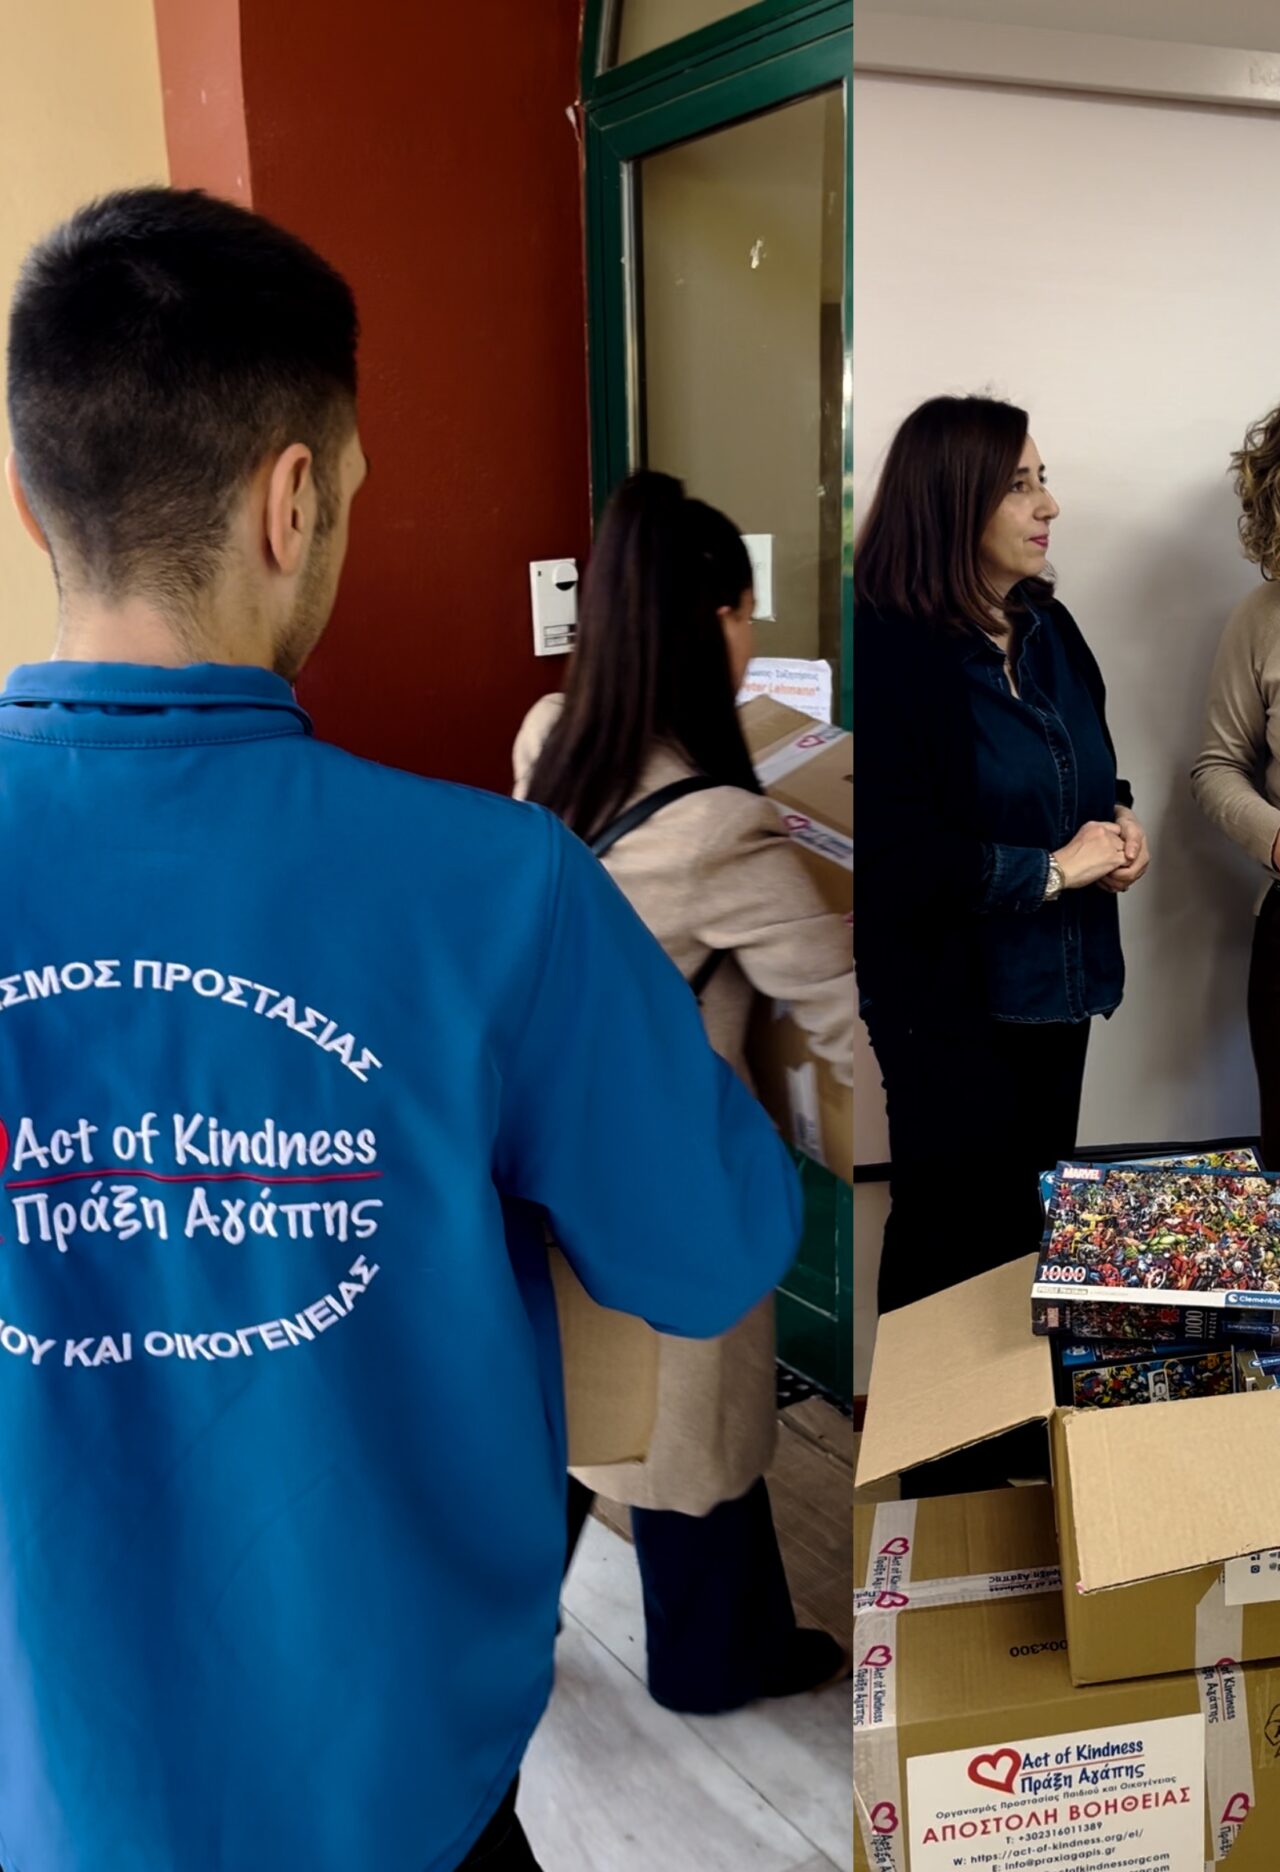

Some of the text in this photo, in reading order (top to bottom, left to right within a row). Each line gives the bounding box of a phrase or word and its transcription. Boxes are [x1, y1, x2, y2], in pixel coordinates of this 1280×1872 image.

[0, 960, 383, 1083] ΣΜΟΣ ΠΡΟΣΤΑΣΙΑΣ
[12, 1112, 378, 1171] Act of Kindness
[1062, 1167, 1102, 1180] MARVEL
[13, 1181, 384, 1252] Πράξη Αγάπης
[1039, 1265, 1086, 1283] 1000
[0, 1254, 381, 1367] ΟΥ ΚΑΙ ΟΙΚΟΓΕΝΕΙΑΣ
[1185, 1310, 1203, 1339] 1000
[874, 1667, 886, 1679] Act
[873, 1690, 886, 1723] Kindness
[1206, 1682, 1220, 1724] Αγάπης
[1222, 1677, 1236, 1720] Kindness
[1021, 1739, 1144, 1770] Act of Kindness
[1020, 1763, 1146, 1796] Πράξη Αγάπης
[922, 1786, 1192, 1845] ΑΠΟΣΤΟΛΗ ΒΟΗΘΕΙΑΣ
[935, 1775, 1177, 1821] Οργανισμός Προστασίας Παιδιού και Οικογένειας
[953, 1828, 1144, 1867] W: https://act-of-kindness.org/el/
[1005, 1821, 1103, 1845] T: +302316011389
[1004, 1846, 1116, 1872] info@praxiagapis.gr
